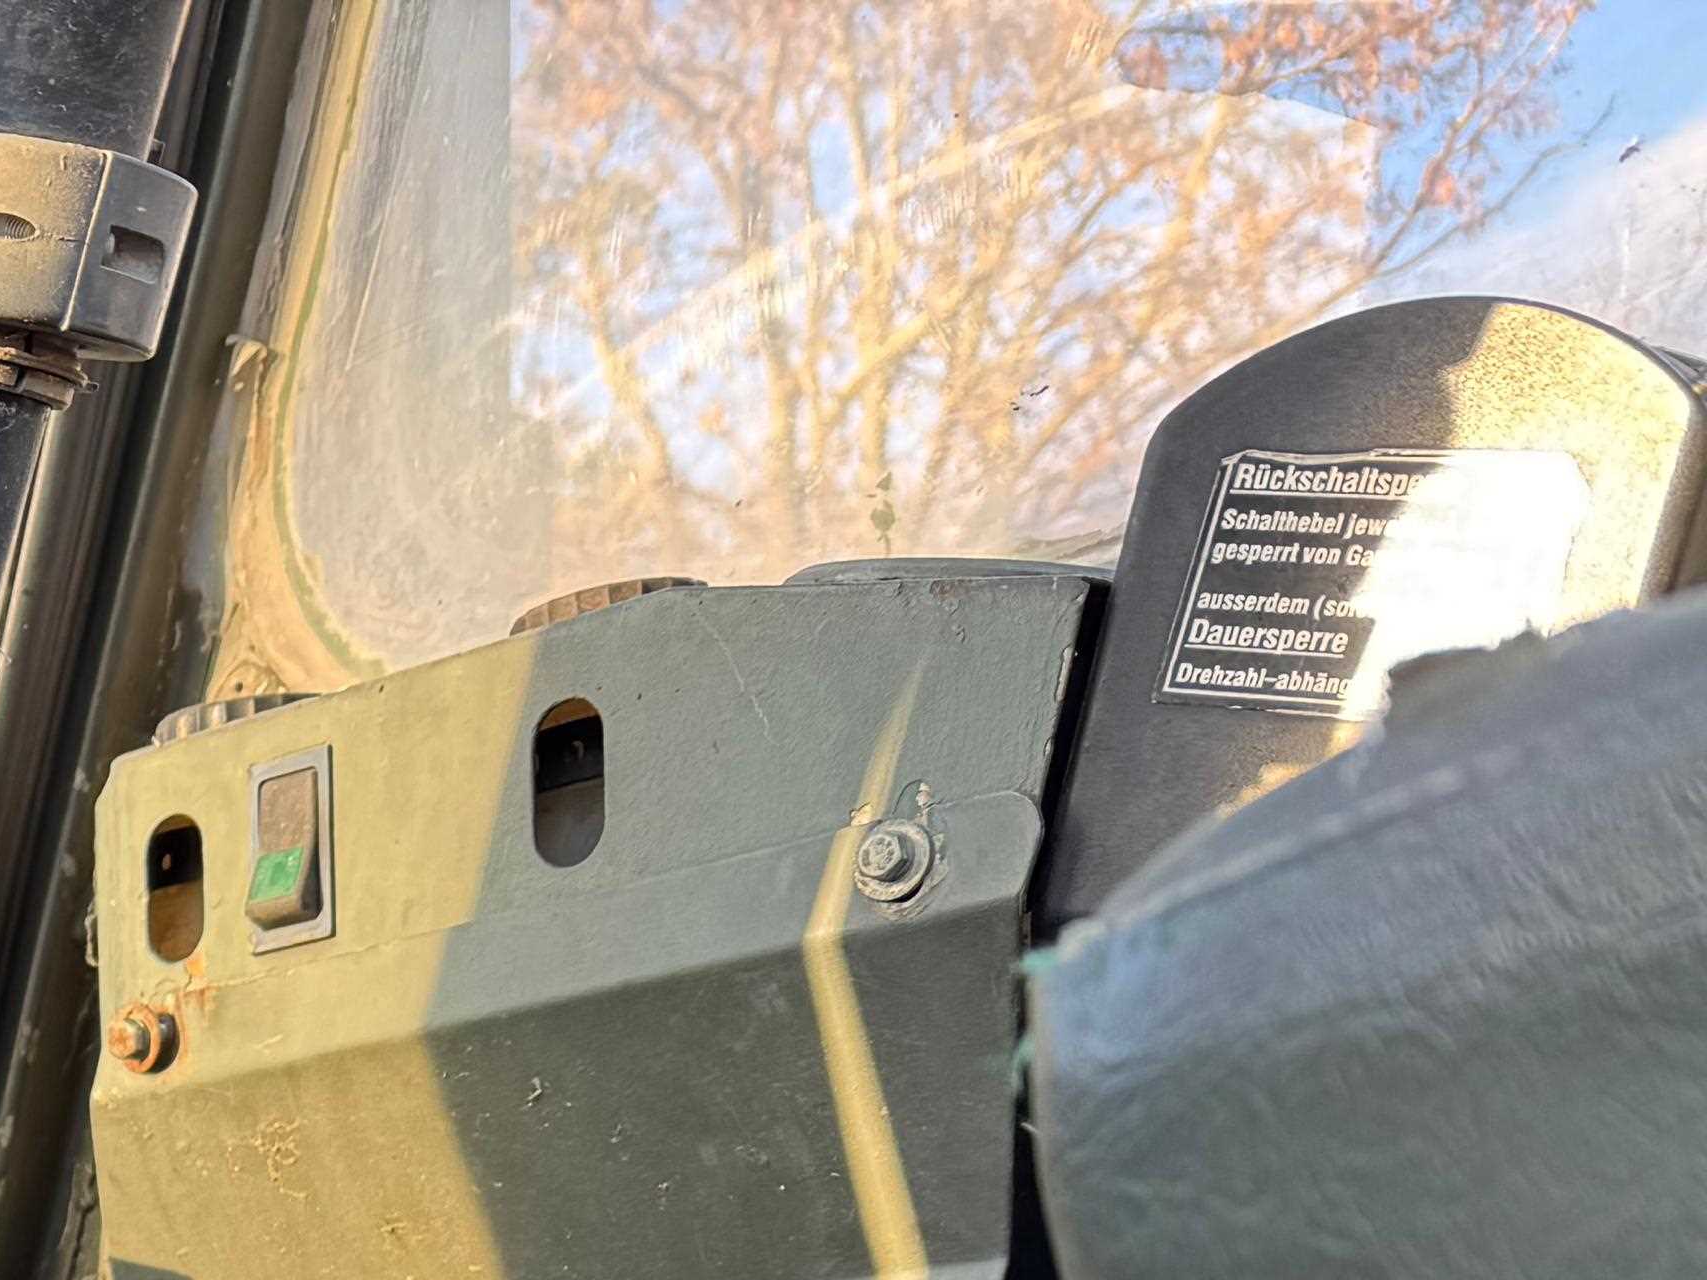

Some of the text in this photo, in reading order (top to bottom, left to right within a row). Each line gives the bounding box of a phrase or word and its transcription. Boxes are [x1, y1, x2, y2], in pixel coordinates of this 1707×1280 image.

[1233, 463, 1420, 495] Rückschaltspe
[1221, 508, 1343, 534] Schalthebel
[1211, 542, 1299, 565] gesperrt
[1303, 546, 1341, 565] von
[1197, 591, 1309, 616] ausserdem
[1187, 618, 1349, 654] Dauersperre
[1175, 662, 1355, 696] Drehzahl-abhäng
